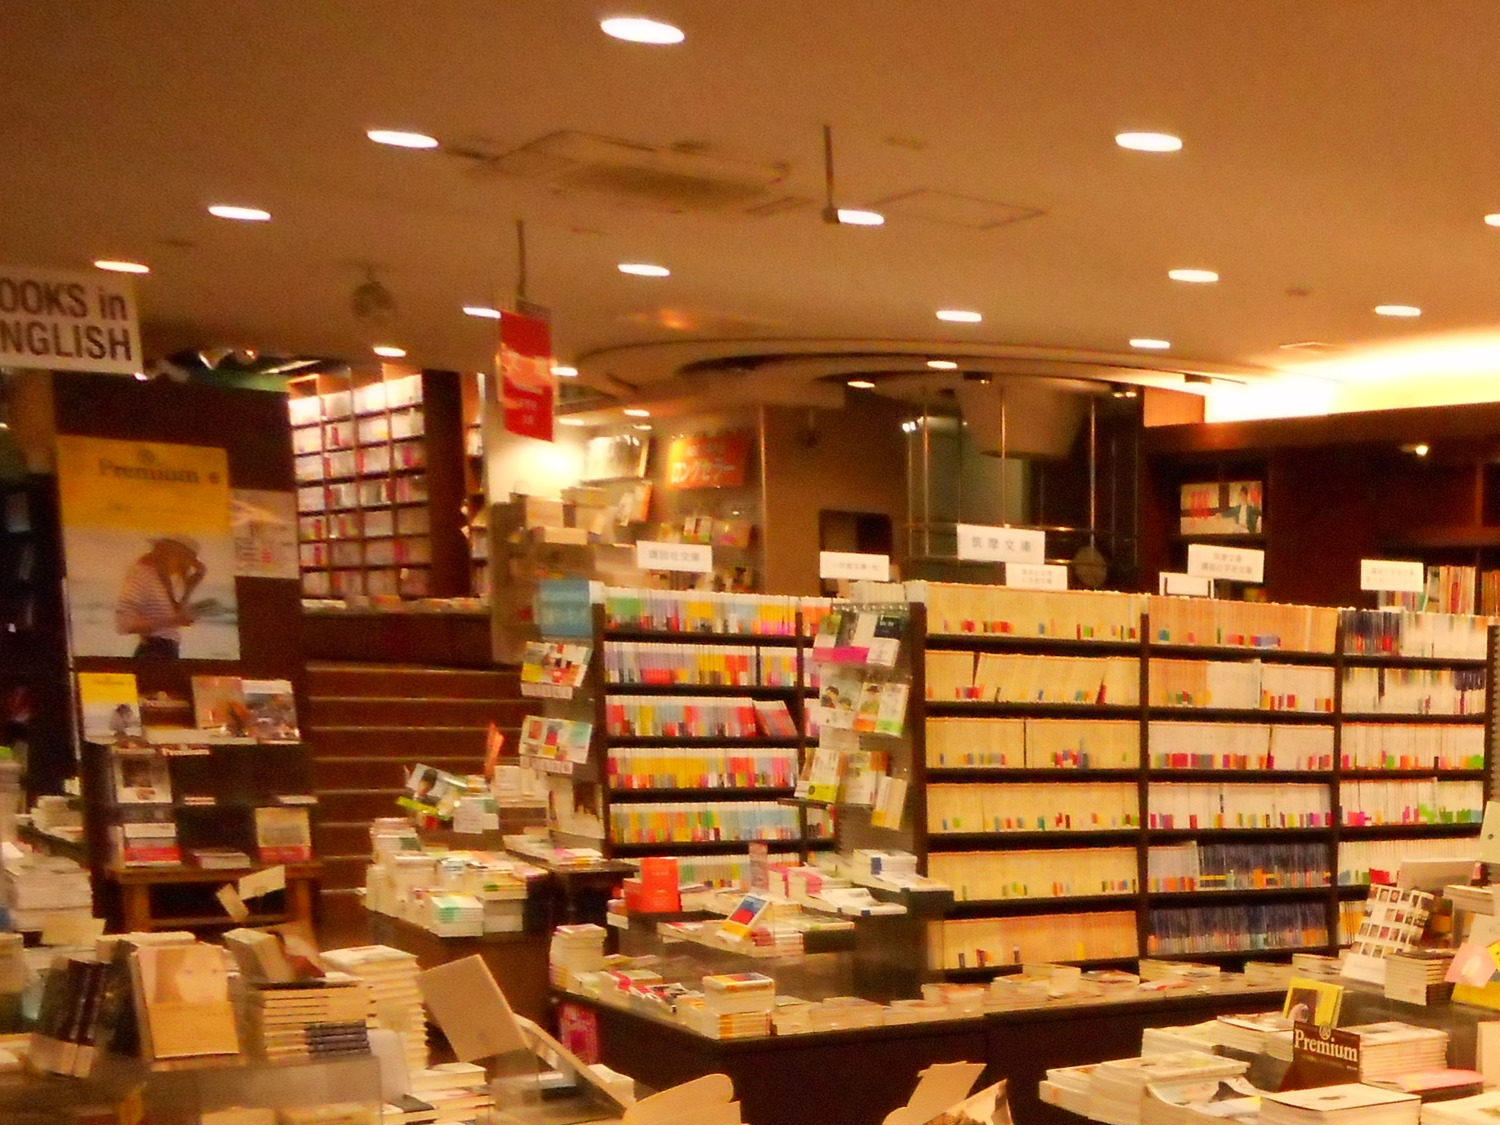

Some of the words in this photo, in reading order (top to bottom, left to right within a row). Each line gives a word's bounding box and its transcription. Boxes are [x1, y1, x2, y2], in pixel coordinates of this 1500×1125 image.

[0, 278, 88, 318] OOKS
[98, 284, 128, 320] in
[0, 320, 132, 361] NGLISH
[1294, 1030, 1358, 1062] Premium
